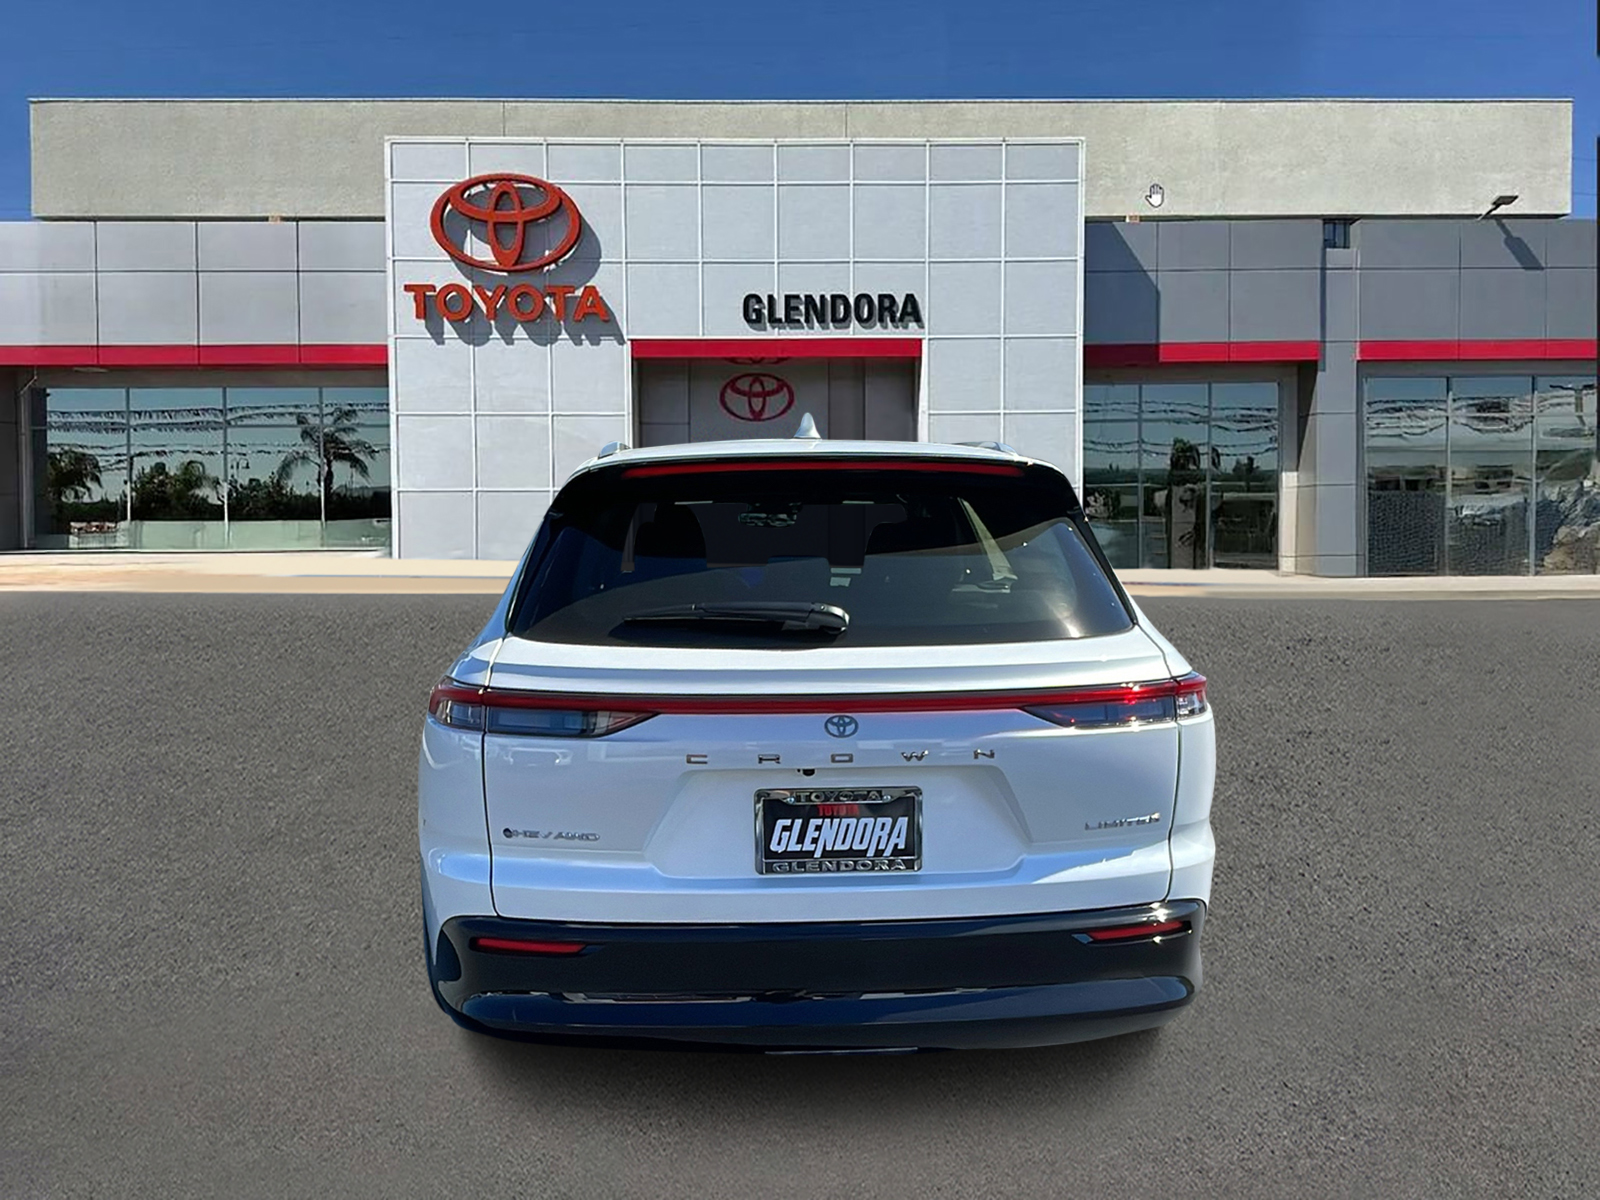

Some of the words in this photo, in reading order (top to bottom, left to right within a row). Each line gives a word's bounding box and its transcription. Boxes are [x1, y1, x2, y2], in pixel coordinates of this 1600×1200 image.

[404, 283, 610, 322] TOYOTA
[743, 293, 922, 324] GLENDORA
[686, 750, 995, 764] CROWN
[796, 791, 882, 802] TOYOTA
[817, 803, 860, 816] TOYOTA
[770, 817, 908, 858] GLENDORA
[772, 860, 907, 872] GLENDORA
